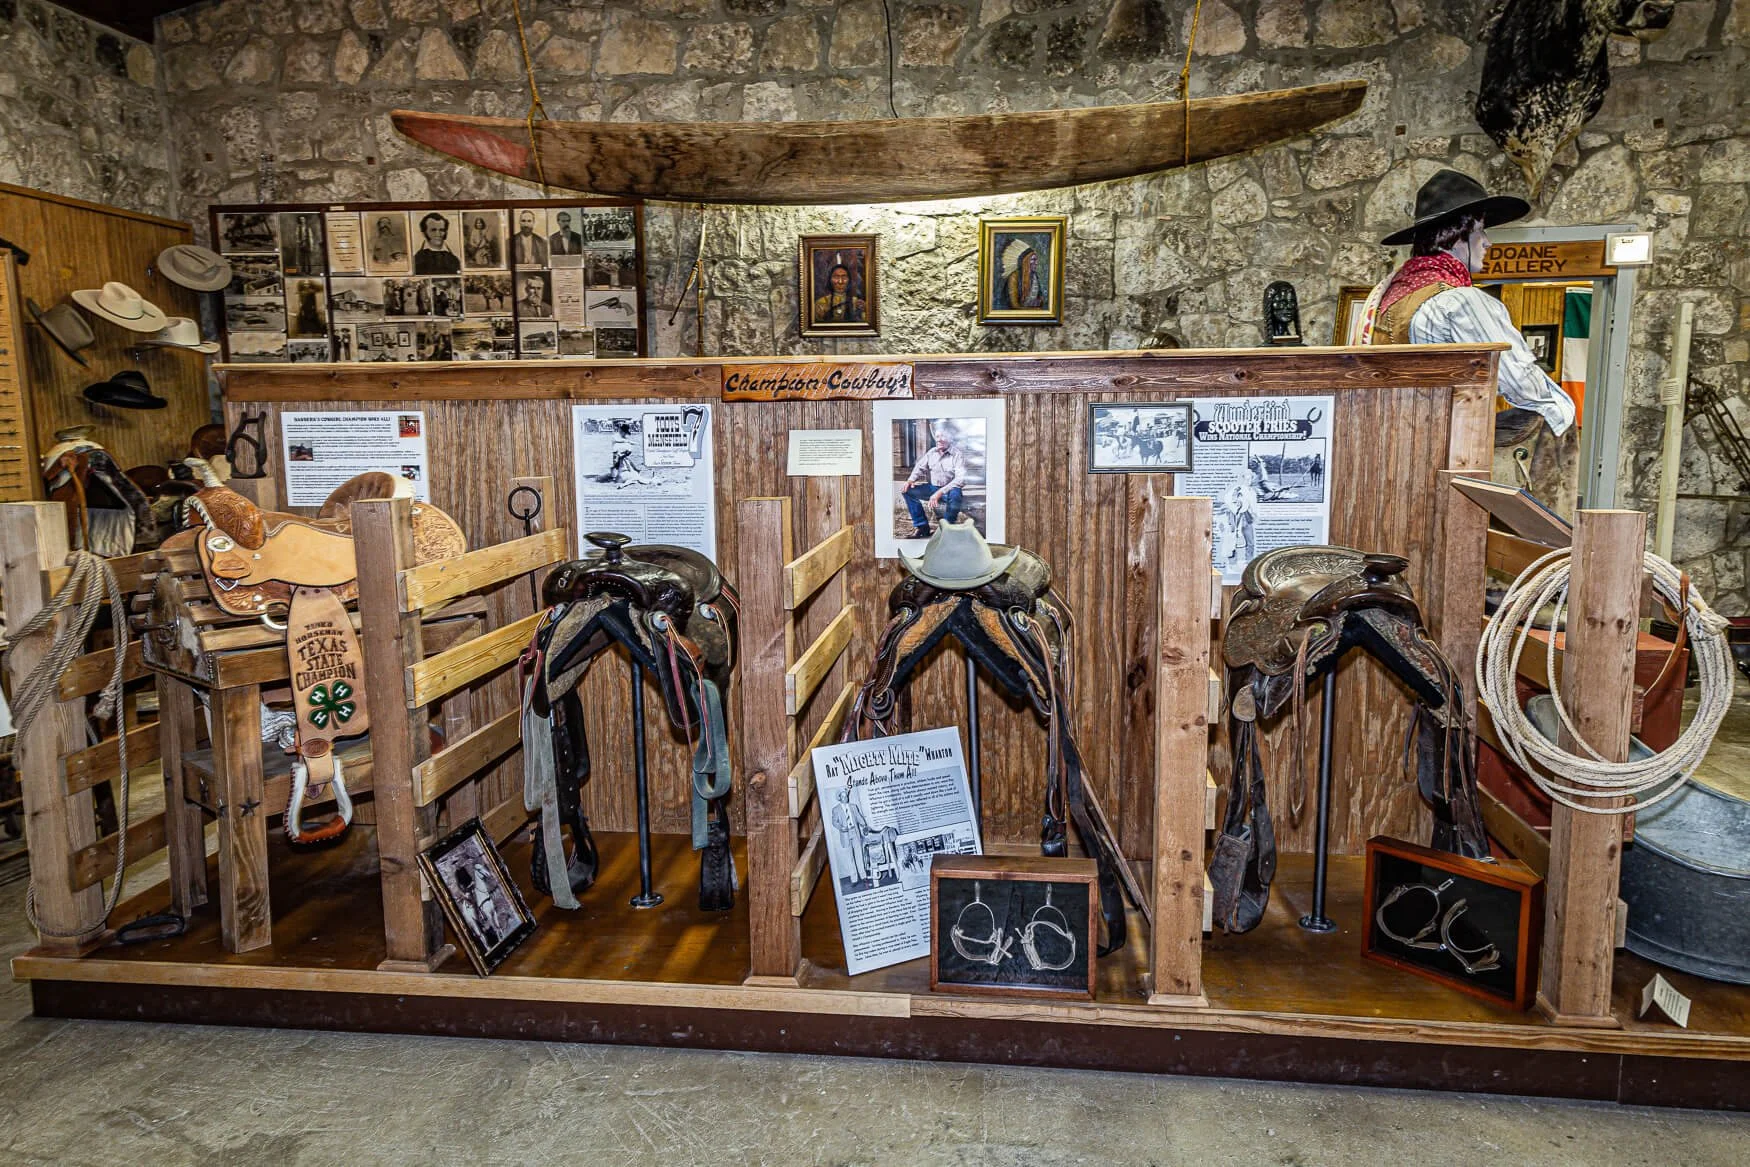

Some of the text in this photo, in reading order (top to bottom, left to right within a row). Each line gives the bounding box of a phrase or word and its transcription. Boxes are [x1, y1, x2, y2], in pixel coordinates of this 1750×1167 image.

[1490, 246, 1557, 260] DOANE
[1480, 259, 1568, 274] GALLERY
[725, 370, 907, 397] Champion Cowboys
[1214, 398, 1291, 422] Wunderkind
[655, 416, 680, 433] TOOTS
[1208, 420, 1298, 433] SCOOTER FRIES
[297, 637, 348, 661] TEXAS
[306, 653, 344, 671] STATE
[296, 662, 357, 692] CHAMPION
[906, 765, 917, 779] All
